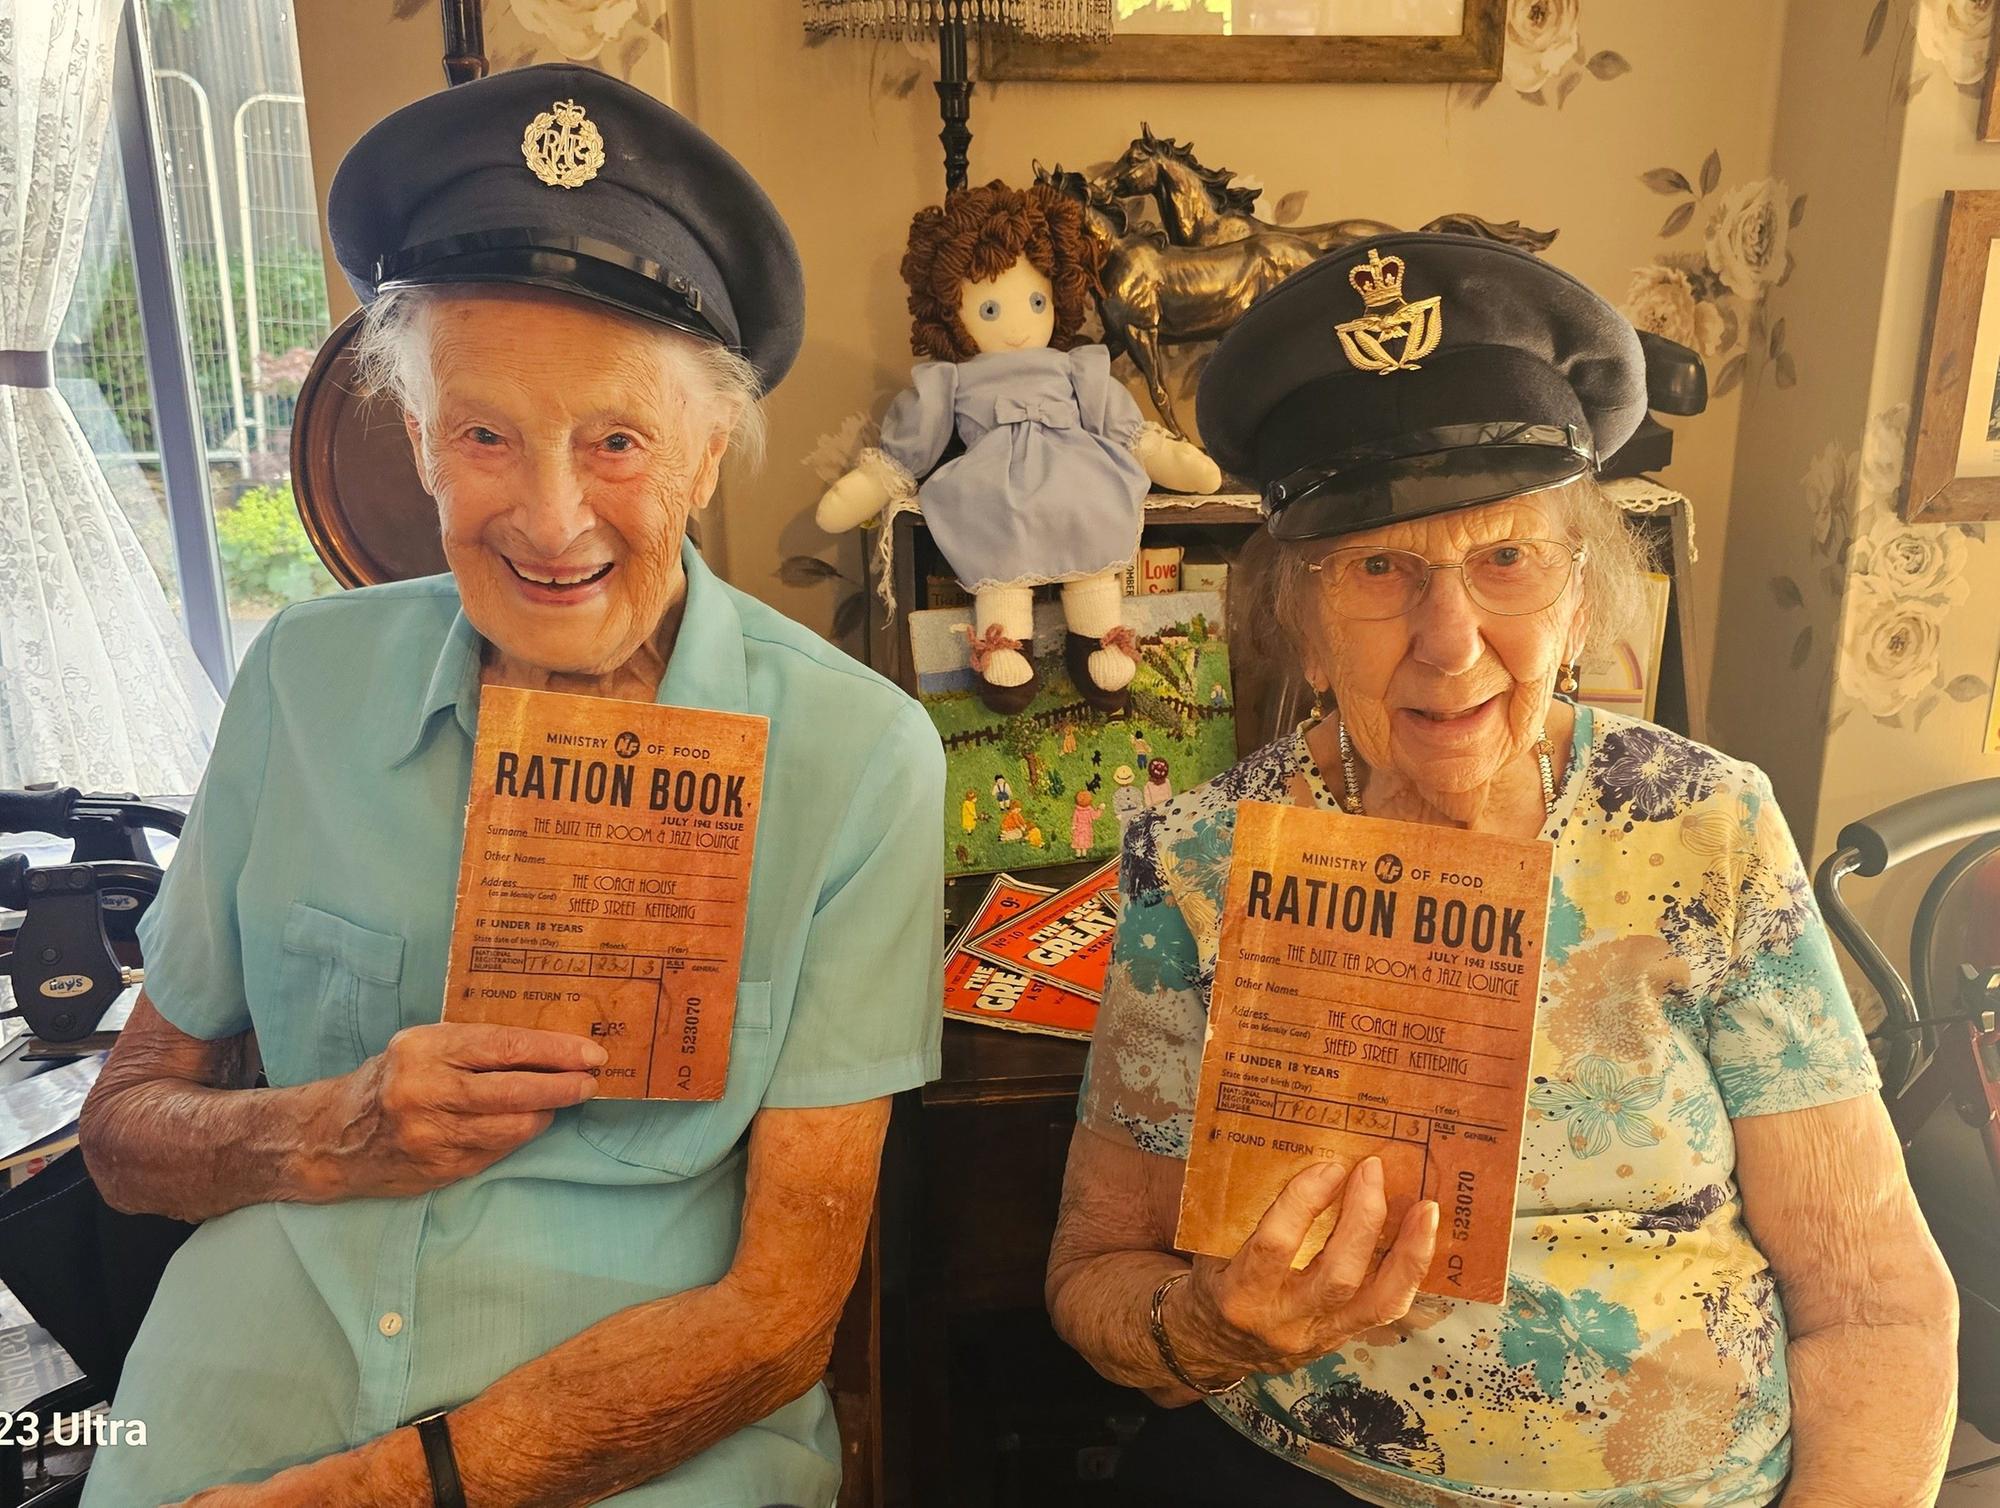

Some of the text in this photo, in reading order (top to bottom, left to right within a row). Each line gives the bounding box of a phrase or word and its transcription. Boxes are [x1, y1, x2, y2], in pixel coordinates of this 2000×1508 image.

[1145, 560, 1177, 580] Love
[546, 732, 608, 749] MINISTRY
[647, 744, 665, 755] OF
[673, 747, 711, 760] FOOD
[495, 751, 746, 818] RATION BOOK
[487, 824, 528, 838] Surname
[534, 817, 551, 834] THE
[555, 819, 581, 836] BLITZ
[585, 822, 602, 838] TEA
[607, 824, 652, 842] ROOM
[669, 830, 692, 846] JAZZ
[696, 832, 740, 850] LOUNGE
[661, 816, 689, 827] JULY
[716, 820, 744, 832] ISSUE
[484, 850, 546, 864] Other Names
[1302, 852, 1368, 872] MINISTRY
[1411, 868, 1431, 881] OF
[1440, 872, 1483, 888] FOOD
[480, 874, 677, 895] Address THE COACH HOUSE
[568, 897, 696, 920] SHEEP STREET KETTERING
[1247, 870, 1526, 958] RATION BOOK
[476, 918, 584, 933] IF UNDER 18 YEARS
[1027, 910, 1117, 966] GREAT
[1028, 921, 1069, 944] THE
[1078, 951, 1089, 960] A
[1427, 951, 1525, 974] JULY 1943 ISSUE
[963, 965, 995, 991] THE
[1239, 948, 1281, 965] Surname
[1287, 944, 1306, 962] THE
[1309, 947, 1338, 968] BLITZ
[1342, 952, 1360, 971] TEA
[1365, 956, 1417, 980] ROOM
[1436, 968, 1463, 988] JAZZ
[1467, 972, 1520, 996] LOUNGE
[481, 989, 517, 999] FOUND
[523, 990, 561, 1001] RETURN
[567, 992, 581, 1002] TO
[1234, 976, 1299, 996] Other Names
[1231, 1005, 1447, 1044] Address THE COACH HOUSE
[1290, 1028, 1311, 1040] Card)
[677, 997, 701, 1091] AD 523070
[1323, 1037, 1468, 1075] SHEEP STREET KETTERING
[605, 1068, 636, 1077] OFFICE
[1225, 1051, 1340, 1079] IF UNDER 18 YEARS
[1260, 1074, 1269, 1084] of
[1270, 1076, 1290, 1087] birth
[1291, 1079, 1313, 1093] (Day)
[1357, 1092, 1389, 1105] (Month)
[1434, 1104, 1460, 1116] (Year)
[1227, 1132, 1265, 1147] FOUND
[1272, 1140, 1314, 1155] RETURN
[1319, 1147, 1335, 1159] TO
[1447, 1170, 1475, 1287] AD 523070
